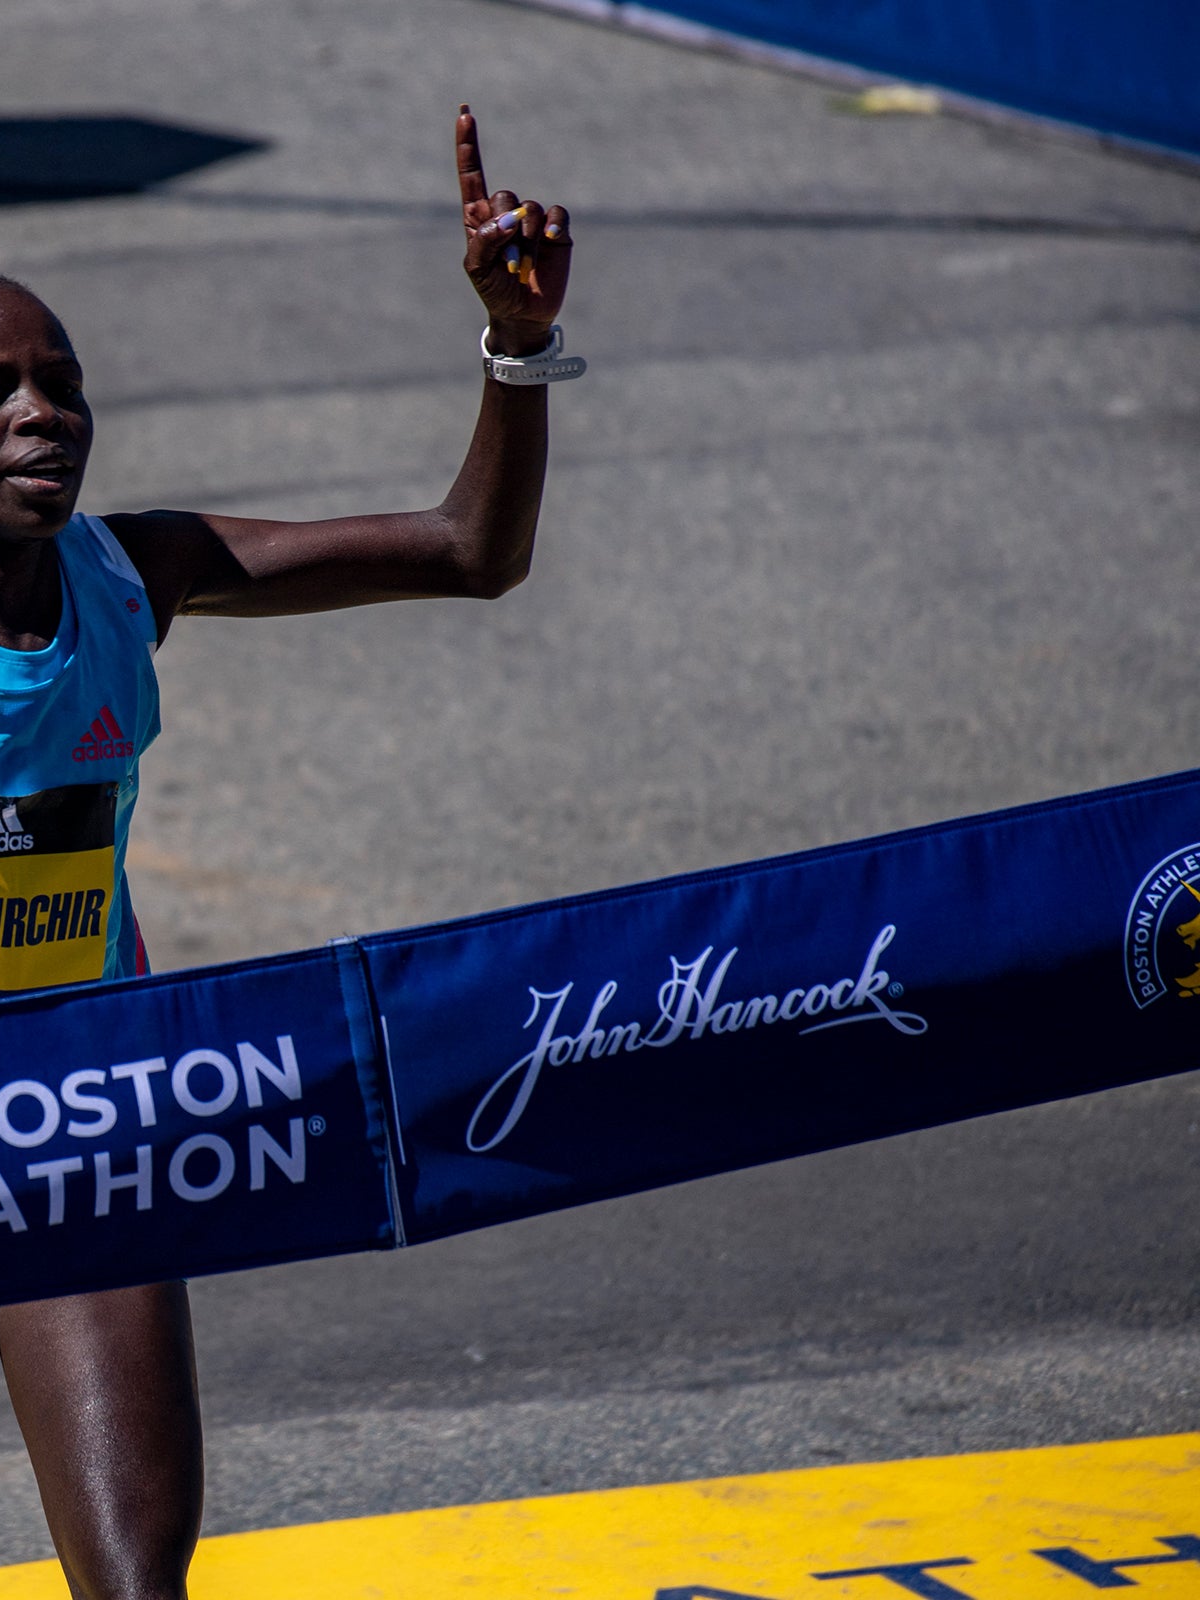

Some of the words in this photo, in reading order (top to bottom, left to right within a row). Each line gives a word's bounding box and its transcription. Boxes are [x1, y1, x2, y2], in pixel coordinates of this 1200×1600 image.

[71, 738, 135, 763] adidas
[1145, 852, 1200, 910] ATHLE
[1134, 910, 1157, 998] BOSTON
[466, 980, 643, 1152] John
